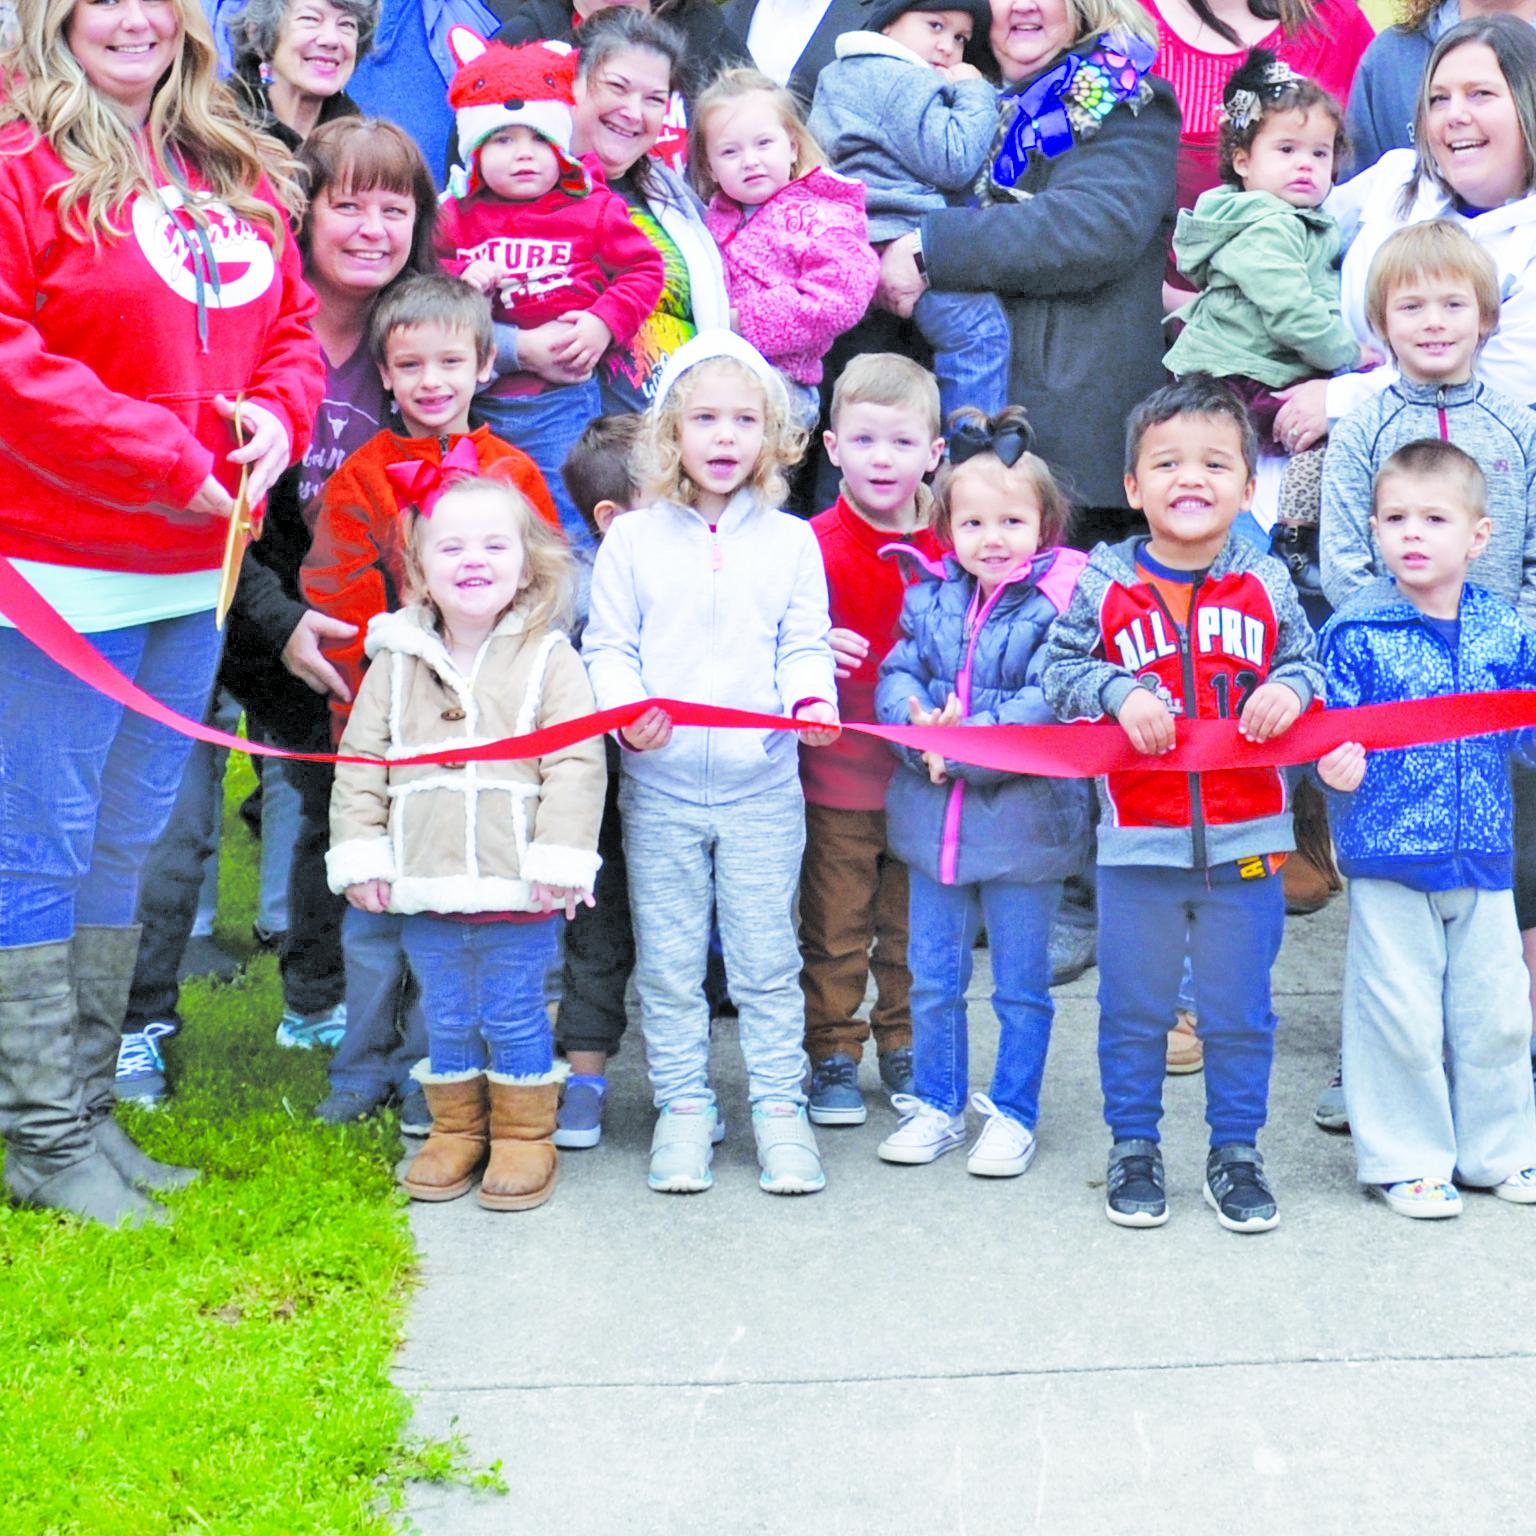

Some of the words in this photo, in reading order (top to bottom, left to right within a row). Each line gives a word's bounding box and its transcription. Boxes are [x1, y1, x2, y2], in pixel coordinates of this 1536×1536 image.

[457, 240, 570, 270] TURE
[1114, 610, 1177, 675] ALL
[1197, 606, 1265, 668] PRO
